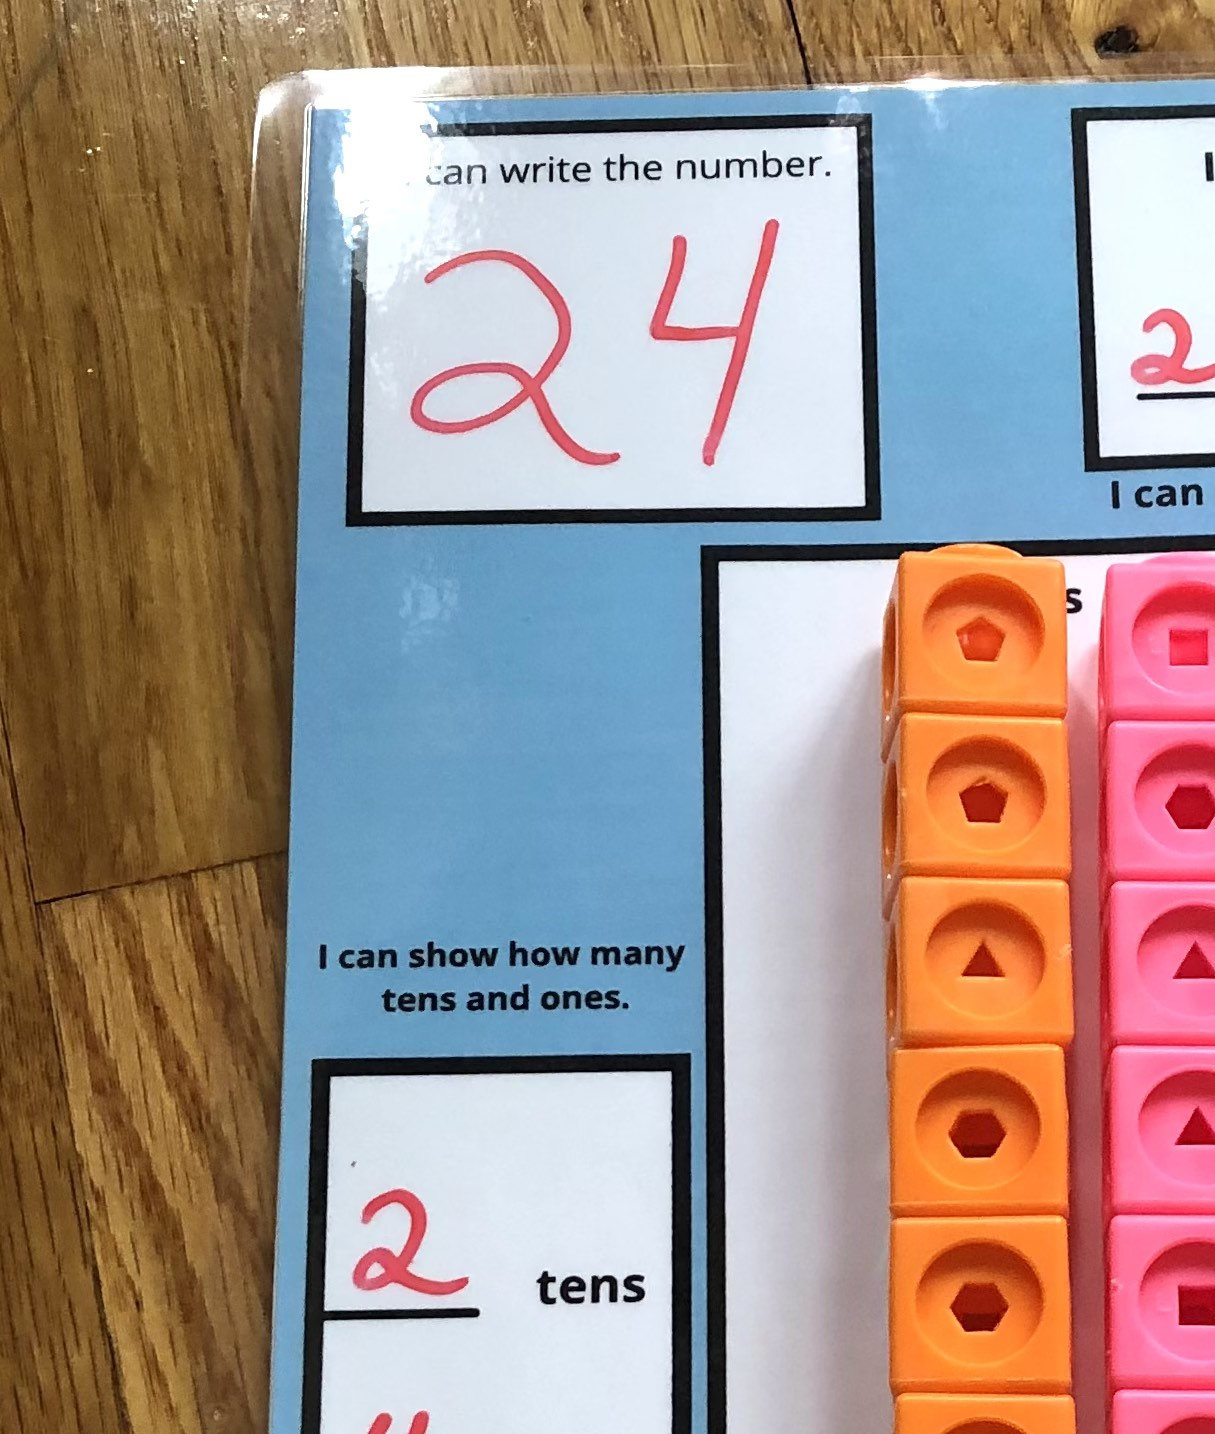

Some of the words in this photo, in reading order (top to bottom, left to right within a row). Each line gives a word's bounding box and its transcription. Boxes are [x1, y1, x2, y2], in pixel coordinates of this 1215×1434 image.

[500, 155, 592, 184] write
[602, 153, 663, 182] the
[676, 149, 831, 180] number.
[1204, 151, 1215, 182] I
[410, 220, 779, 466] 24
[1110, 479, 1120, 509] I
[1133, 483, 1204, 507] can
[319, 944, 327, 970] I
[338, 946, 398, 969] can
[408, 941, 499, 969] show
[509, 940, 581, 967] how
[591, 942, 685, 974] many
[381, 987, 457, 1013] tens
[466, 983, 530, 1012] and
[540, 987, 629, 1011] ones.
[352, 1189, 469, 1296] 2
[536, 1270, 646, 1305] tens
